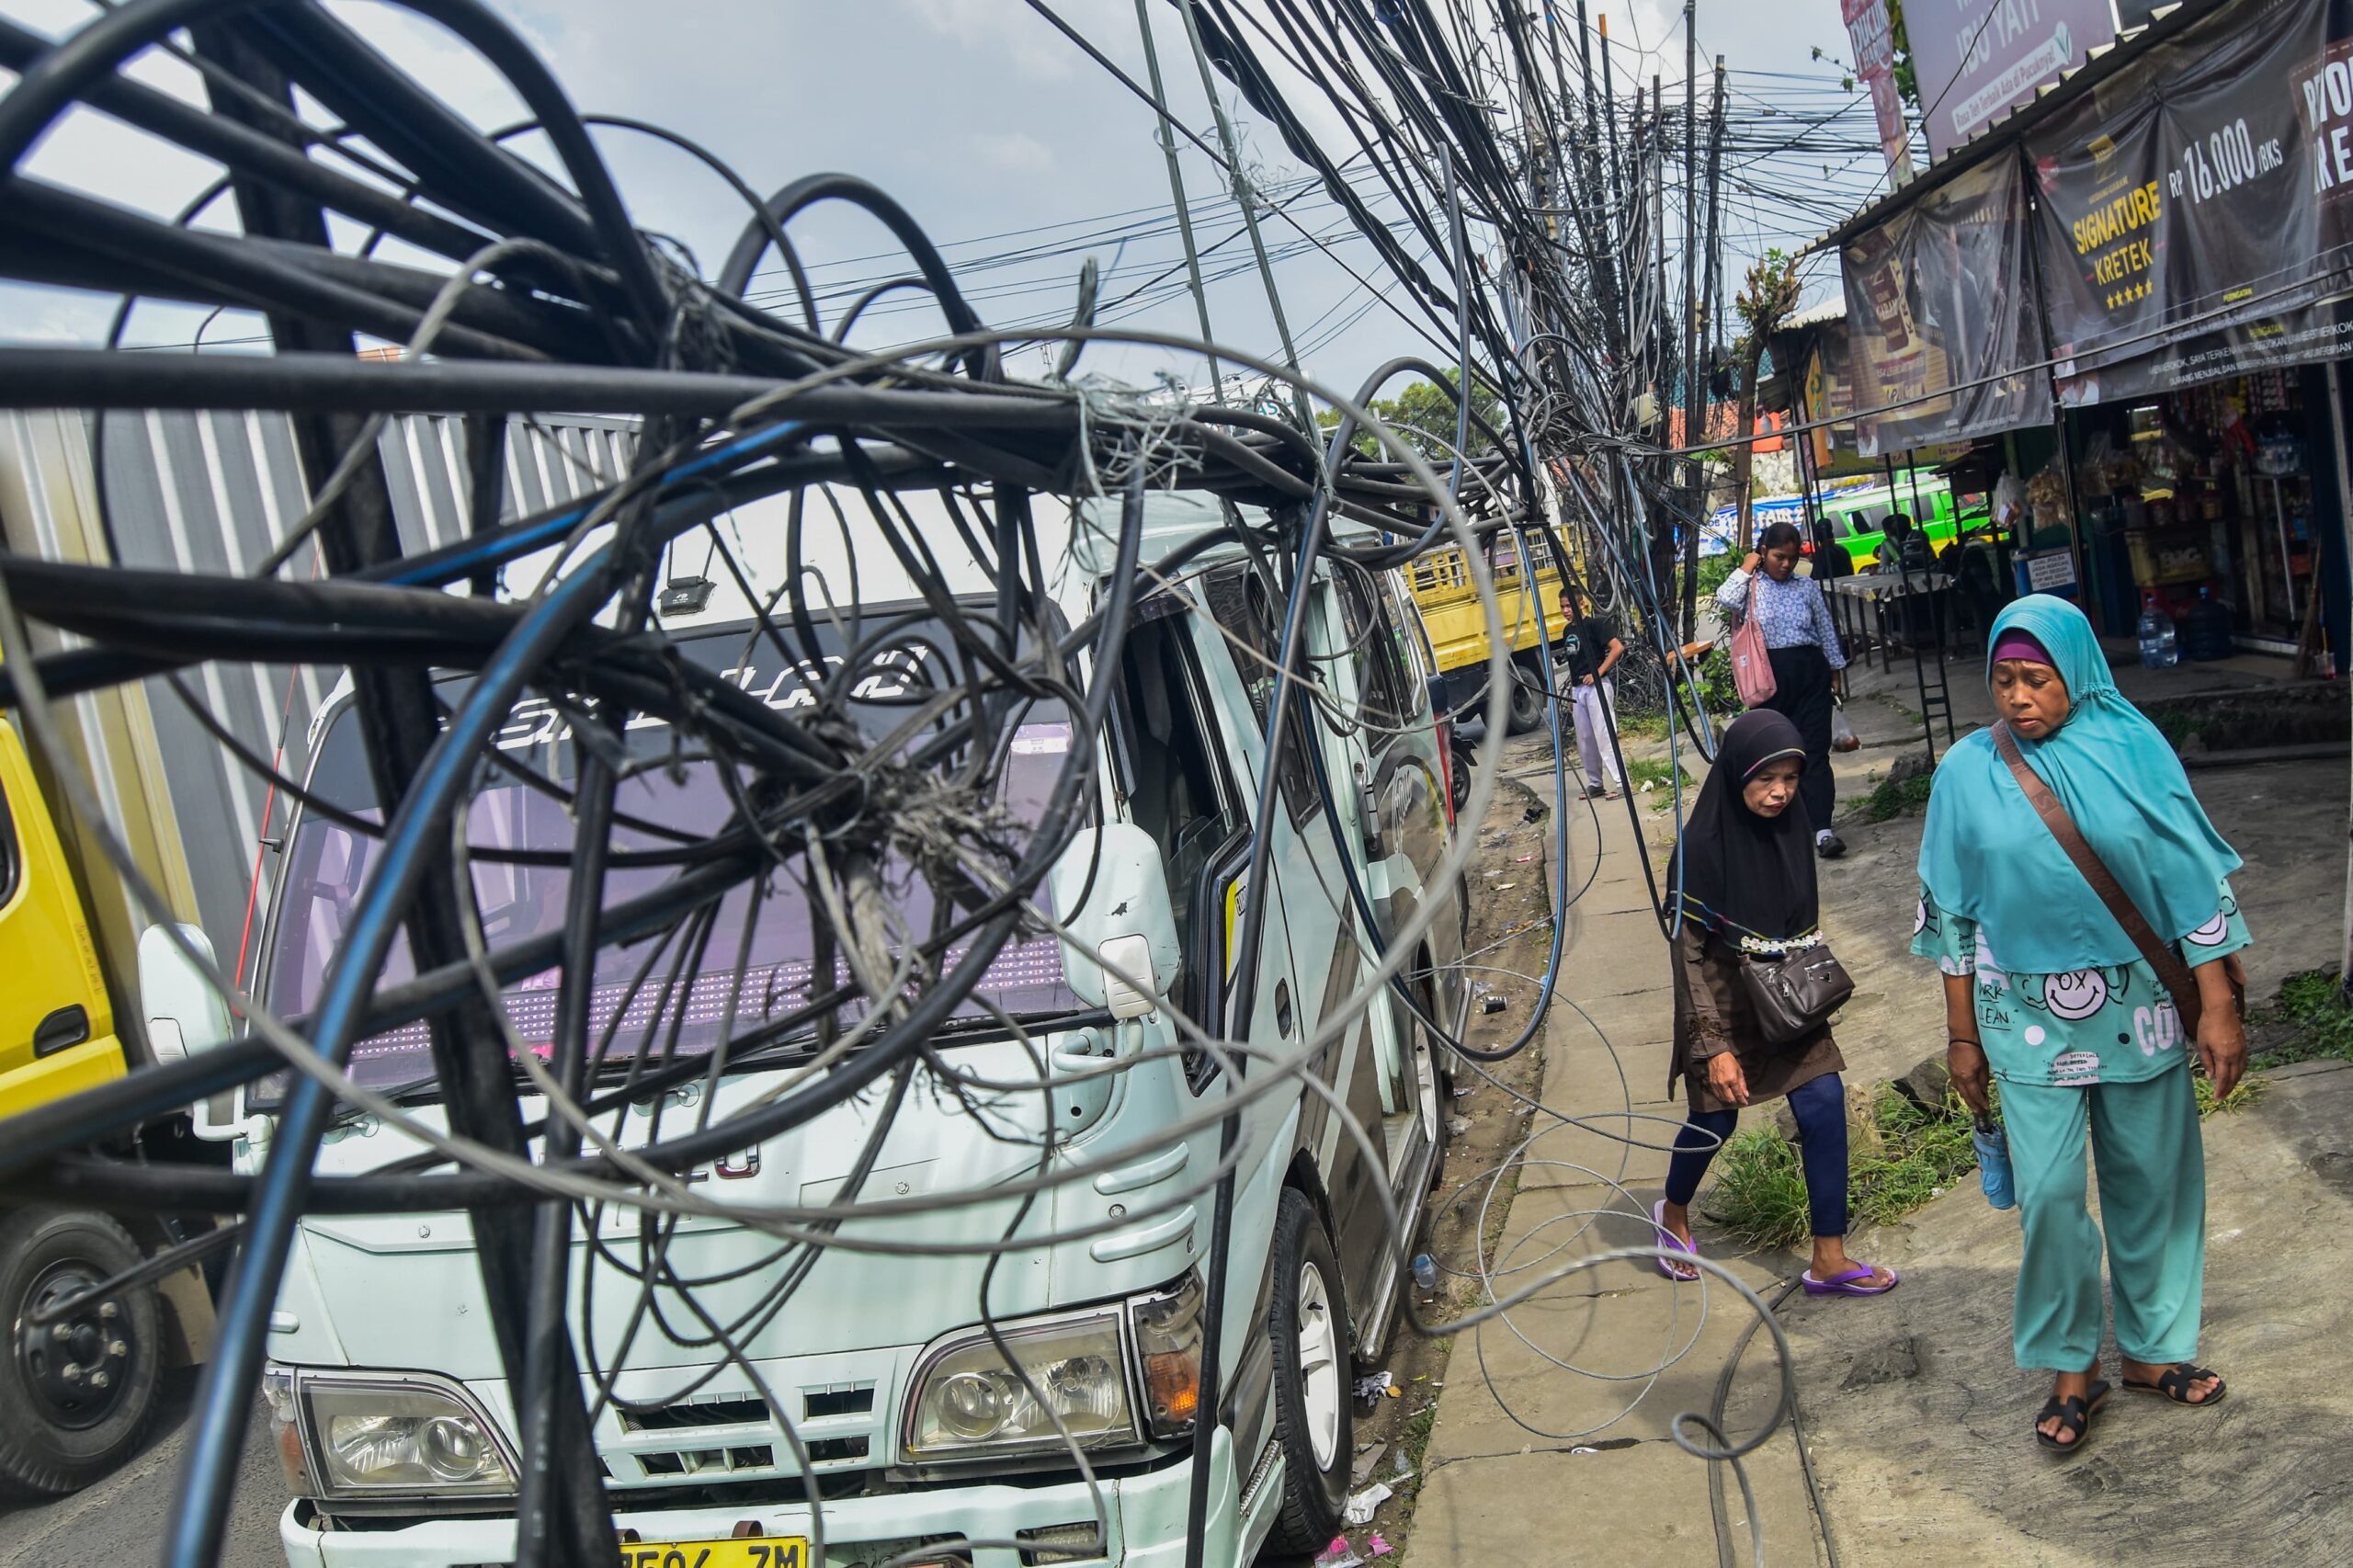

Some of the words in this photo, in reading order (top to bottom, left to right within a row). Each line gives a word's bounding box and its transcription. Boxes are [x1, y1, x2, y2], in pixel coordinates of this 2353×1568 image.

[1956, 13, 1991, 78] IBU
[2168, 169, 2184, 199] RP
[2184, 118, 2256, 204] 16.000
[2257, 138, 2283, 175] /BKS
[2073, 180, 2162, 237] SIGNATURE
[2095, 237, 2154, 287] KRETEK
